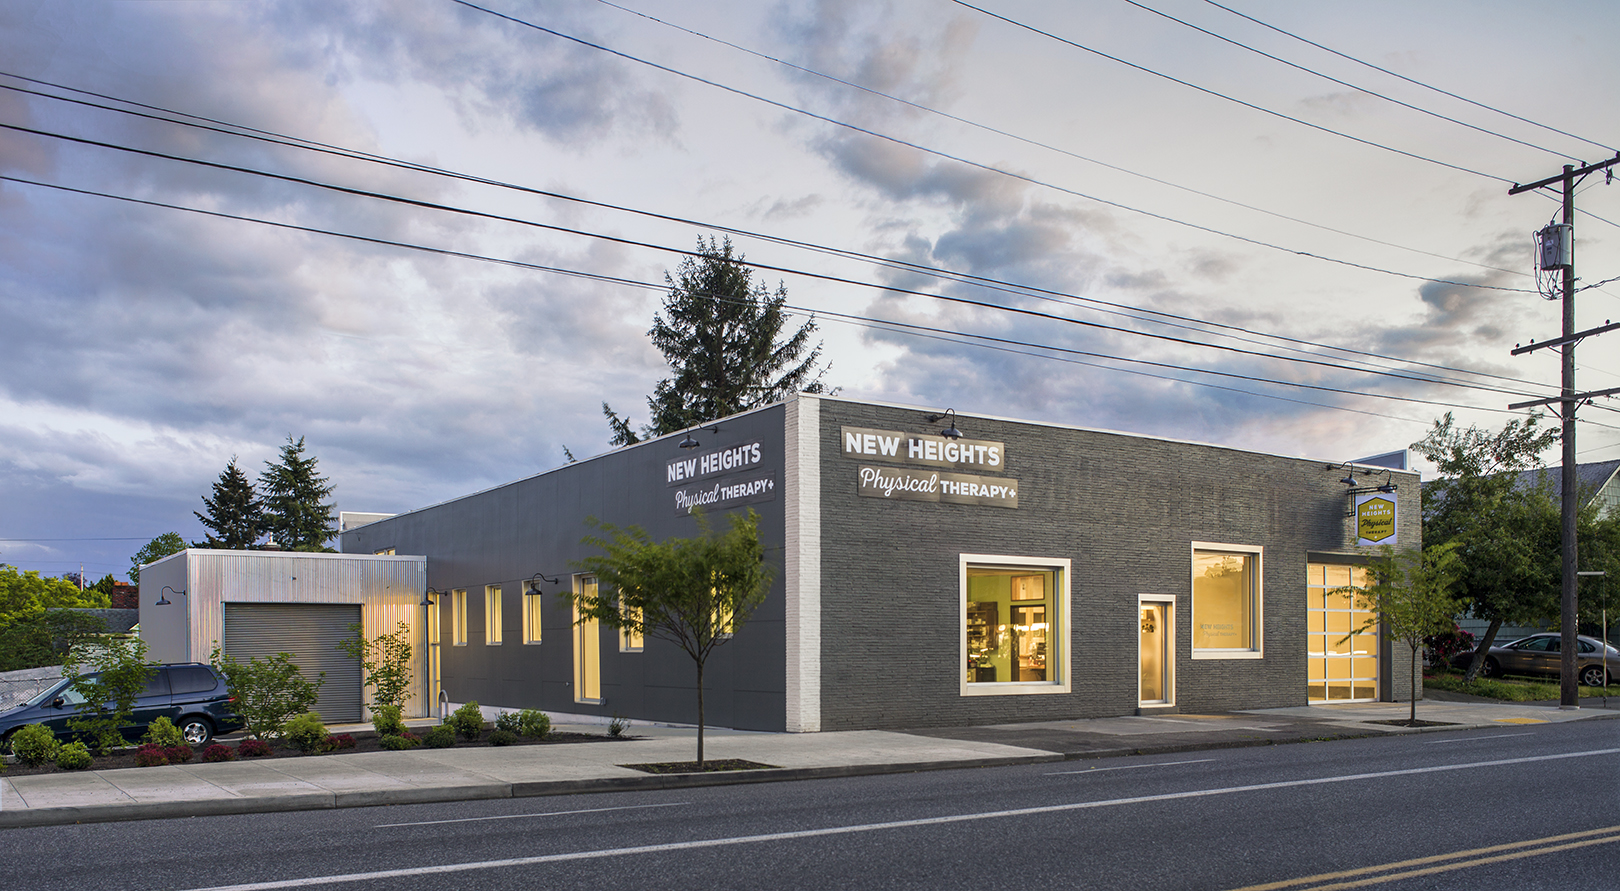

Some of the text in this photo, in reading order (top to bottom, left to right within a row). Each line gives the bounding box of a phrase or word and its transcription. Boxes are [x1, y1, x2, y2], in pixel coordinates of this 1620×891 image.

[667, 442, 761, 483] NEW HEIGHTS
[845, 432, 1000, 467] NEW HEIGHTS
[675, 479, 774, 514] Physical THERAPY+
[860, 467, 1016, 499] Physical THERAPY+
[1361, 517, 1392, 529] Physical
